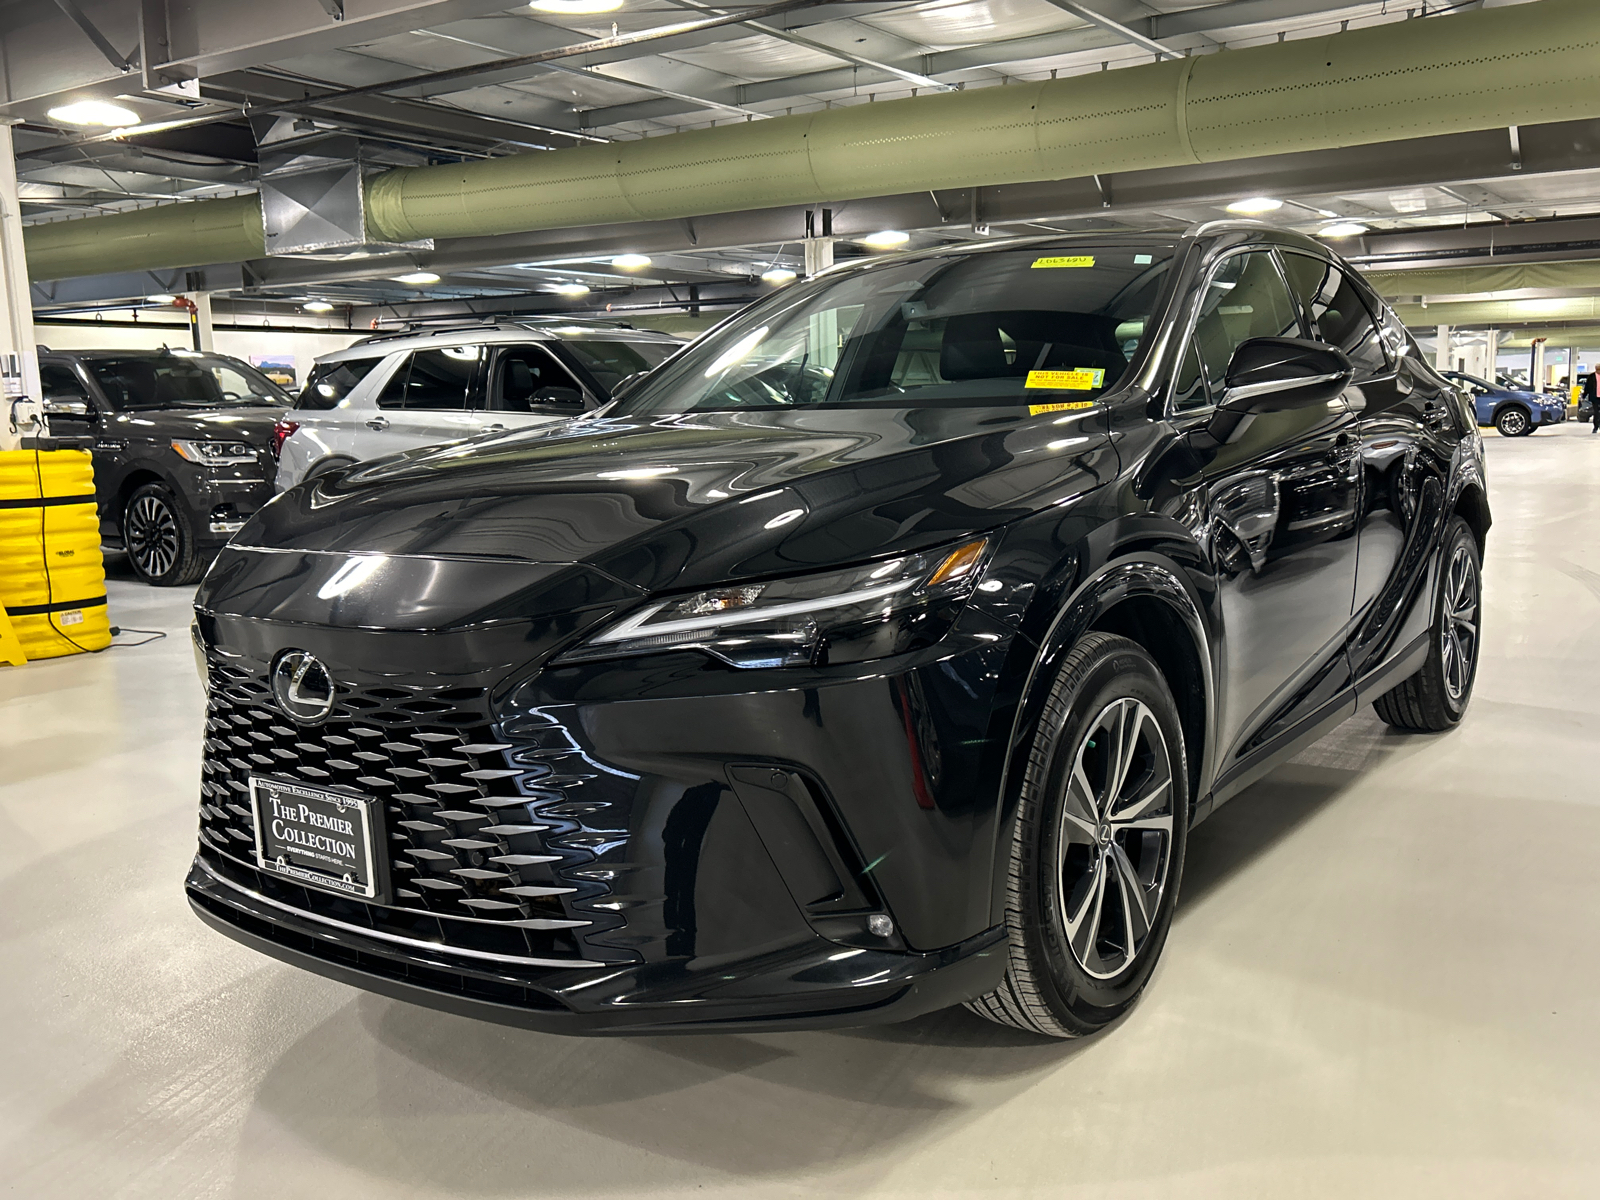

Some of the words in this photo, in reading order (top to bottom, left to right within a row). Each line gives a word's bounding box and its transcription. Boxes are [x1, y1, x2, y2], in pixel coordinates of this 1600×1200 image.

[269, 797, 298, 821] THE
[298, 803, 354, 836] PREMIER
[272, 819, 356, 859] COLLECTION
[286, 845, 315, 858] EVERYTHING
